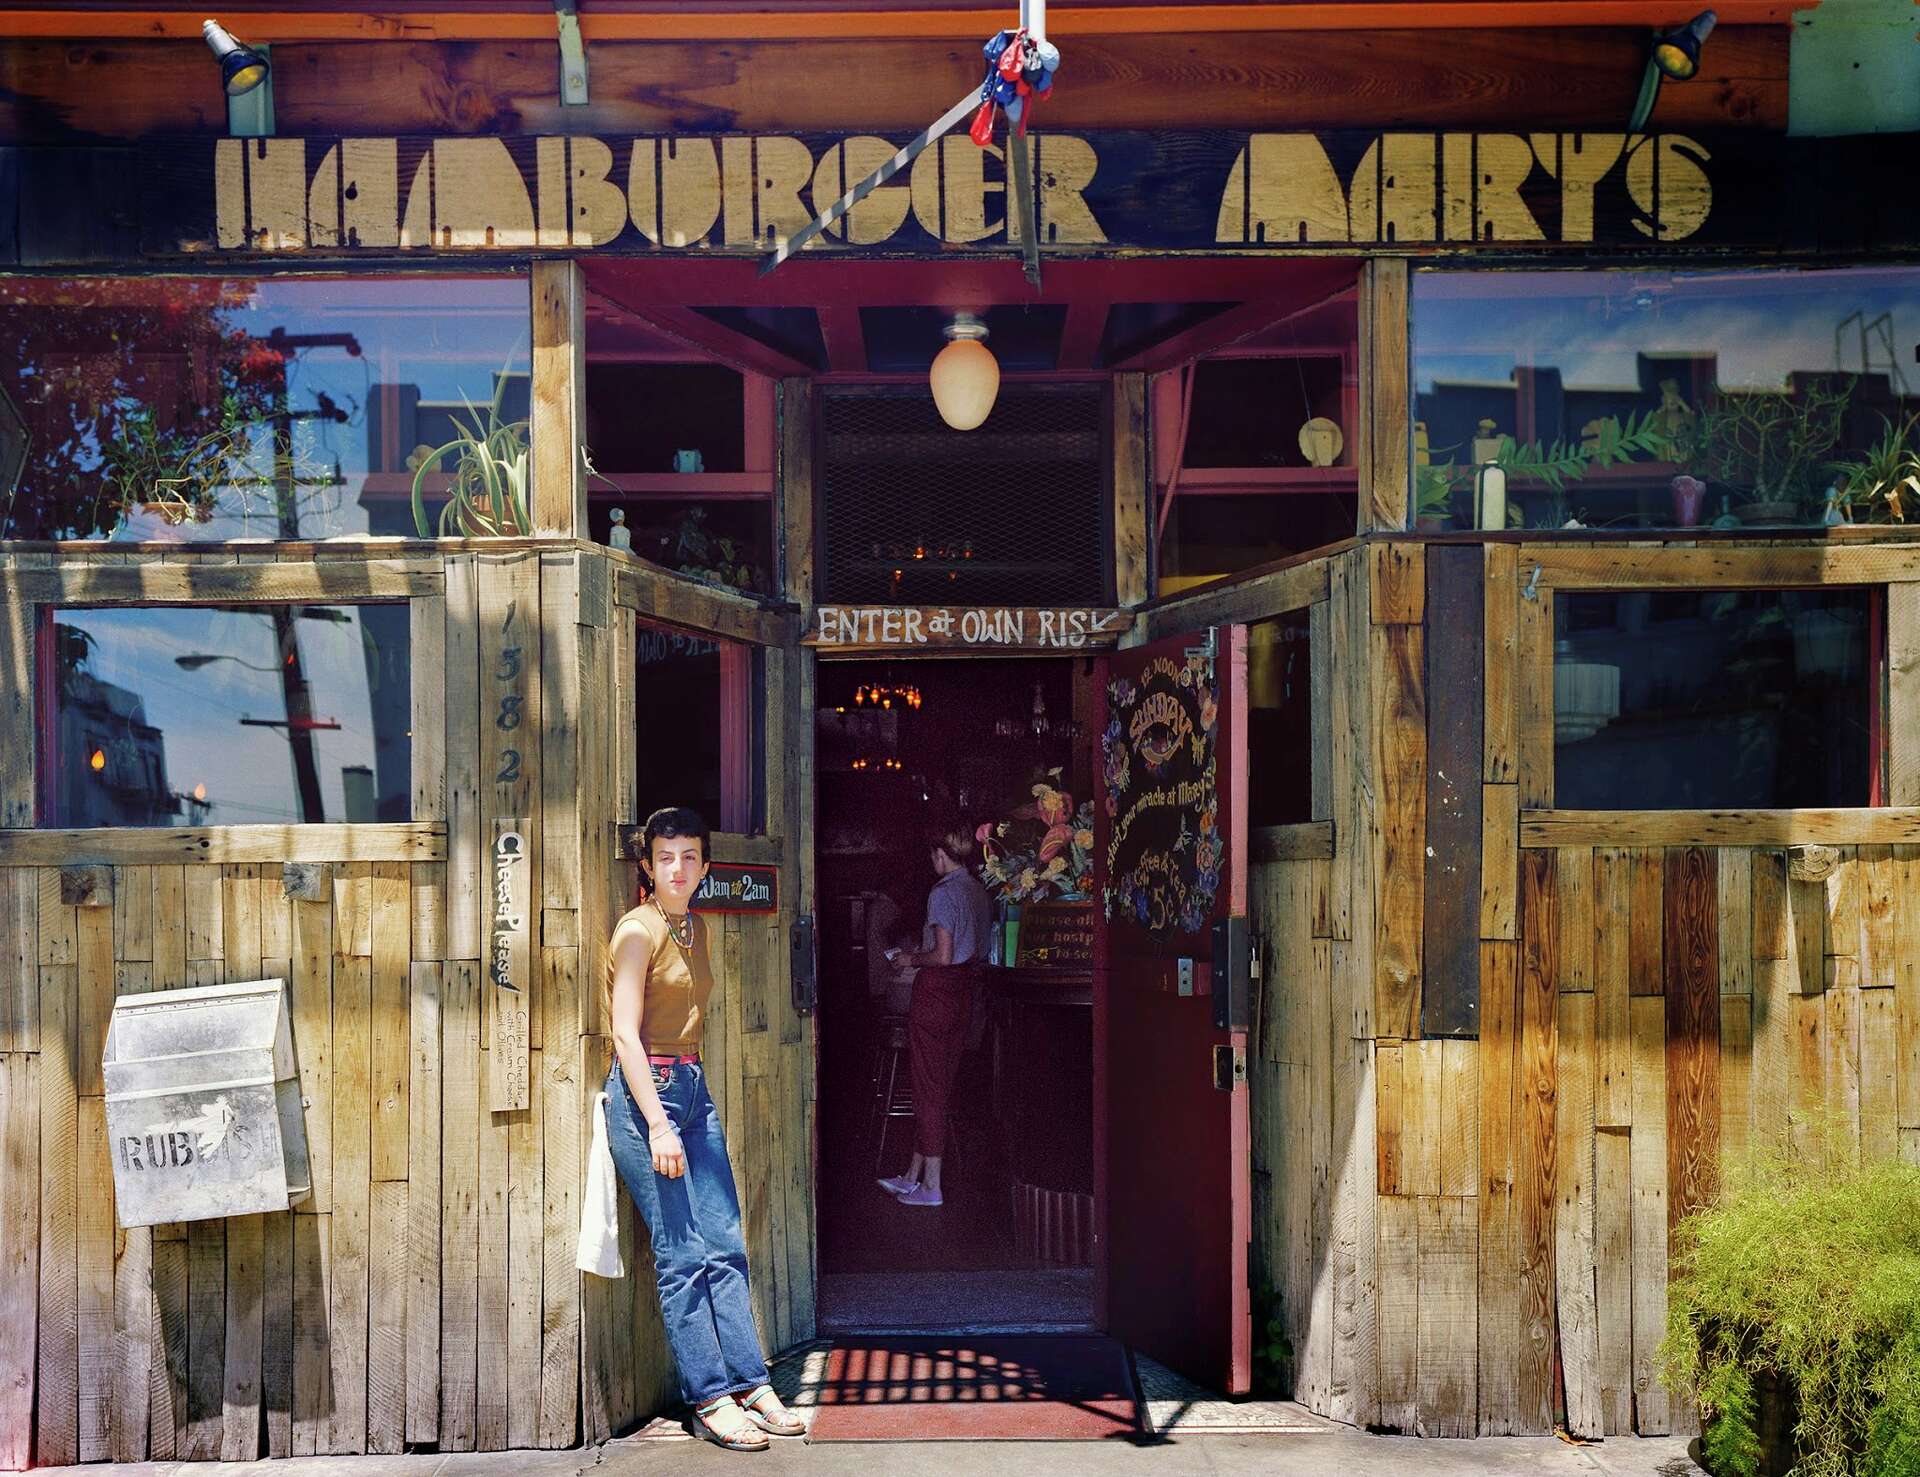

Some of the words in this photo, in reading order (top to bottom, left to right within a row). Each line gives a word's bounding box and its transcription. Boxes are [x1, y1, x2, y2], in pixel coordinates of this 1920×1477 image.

[215, 133, 1109, 248] HAMBURGER
[817, 607, 928, 643] ENTER
[929, 609, 955, 638] at
[961, 608, 1023, 645] OWN
[1038, 610, 1119, 647] RISK
[1166, 786, 1177, 806] at
[743, 875, 769, 901] 2am
[119, 1122, 279, 1171] RUBISH
